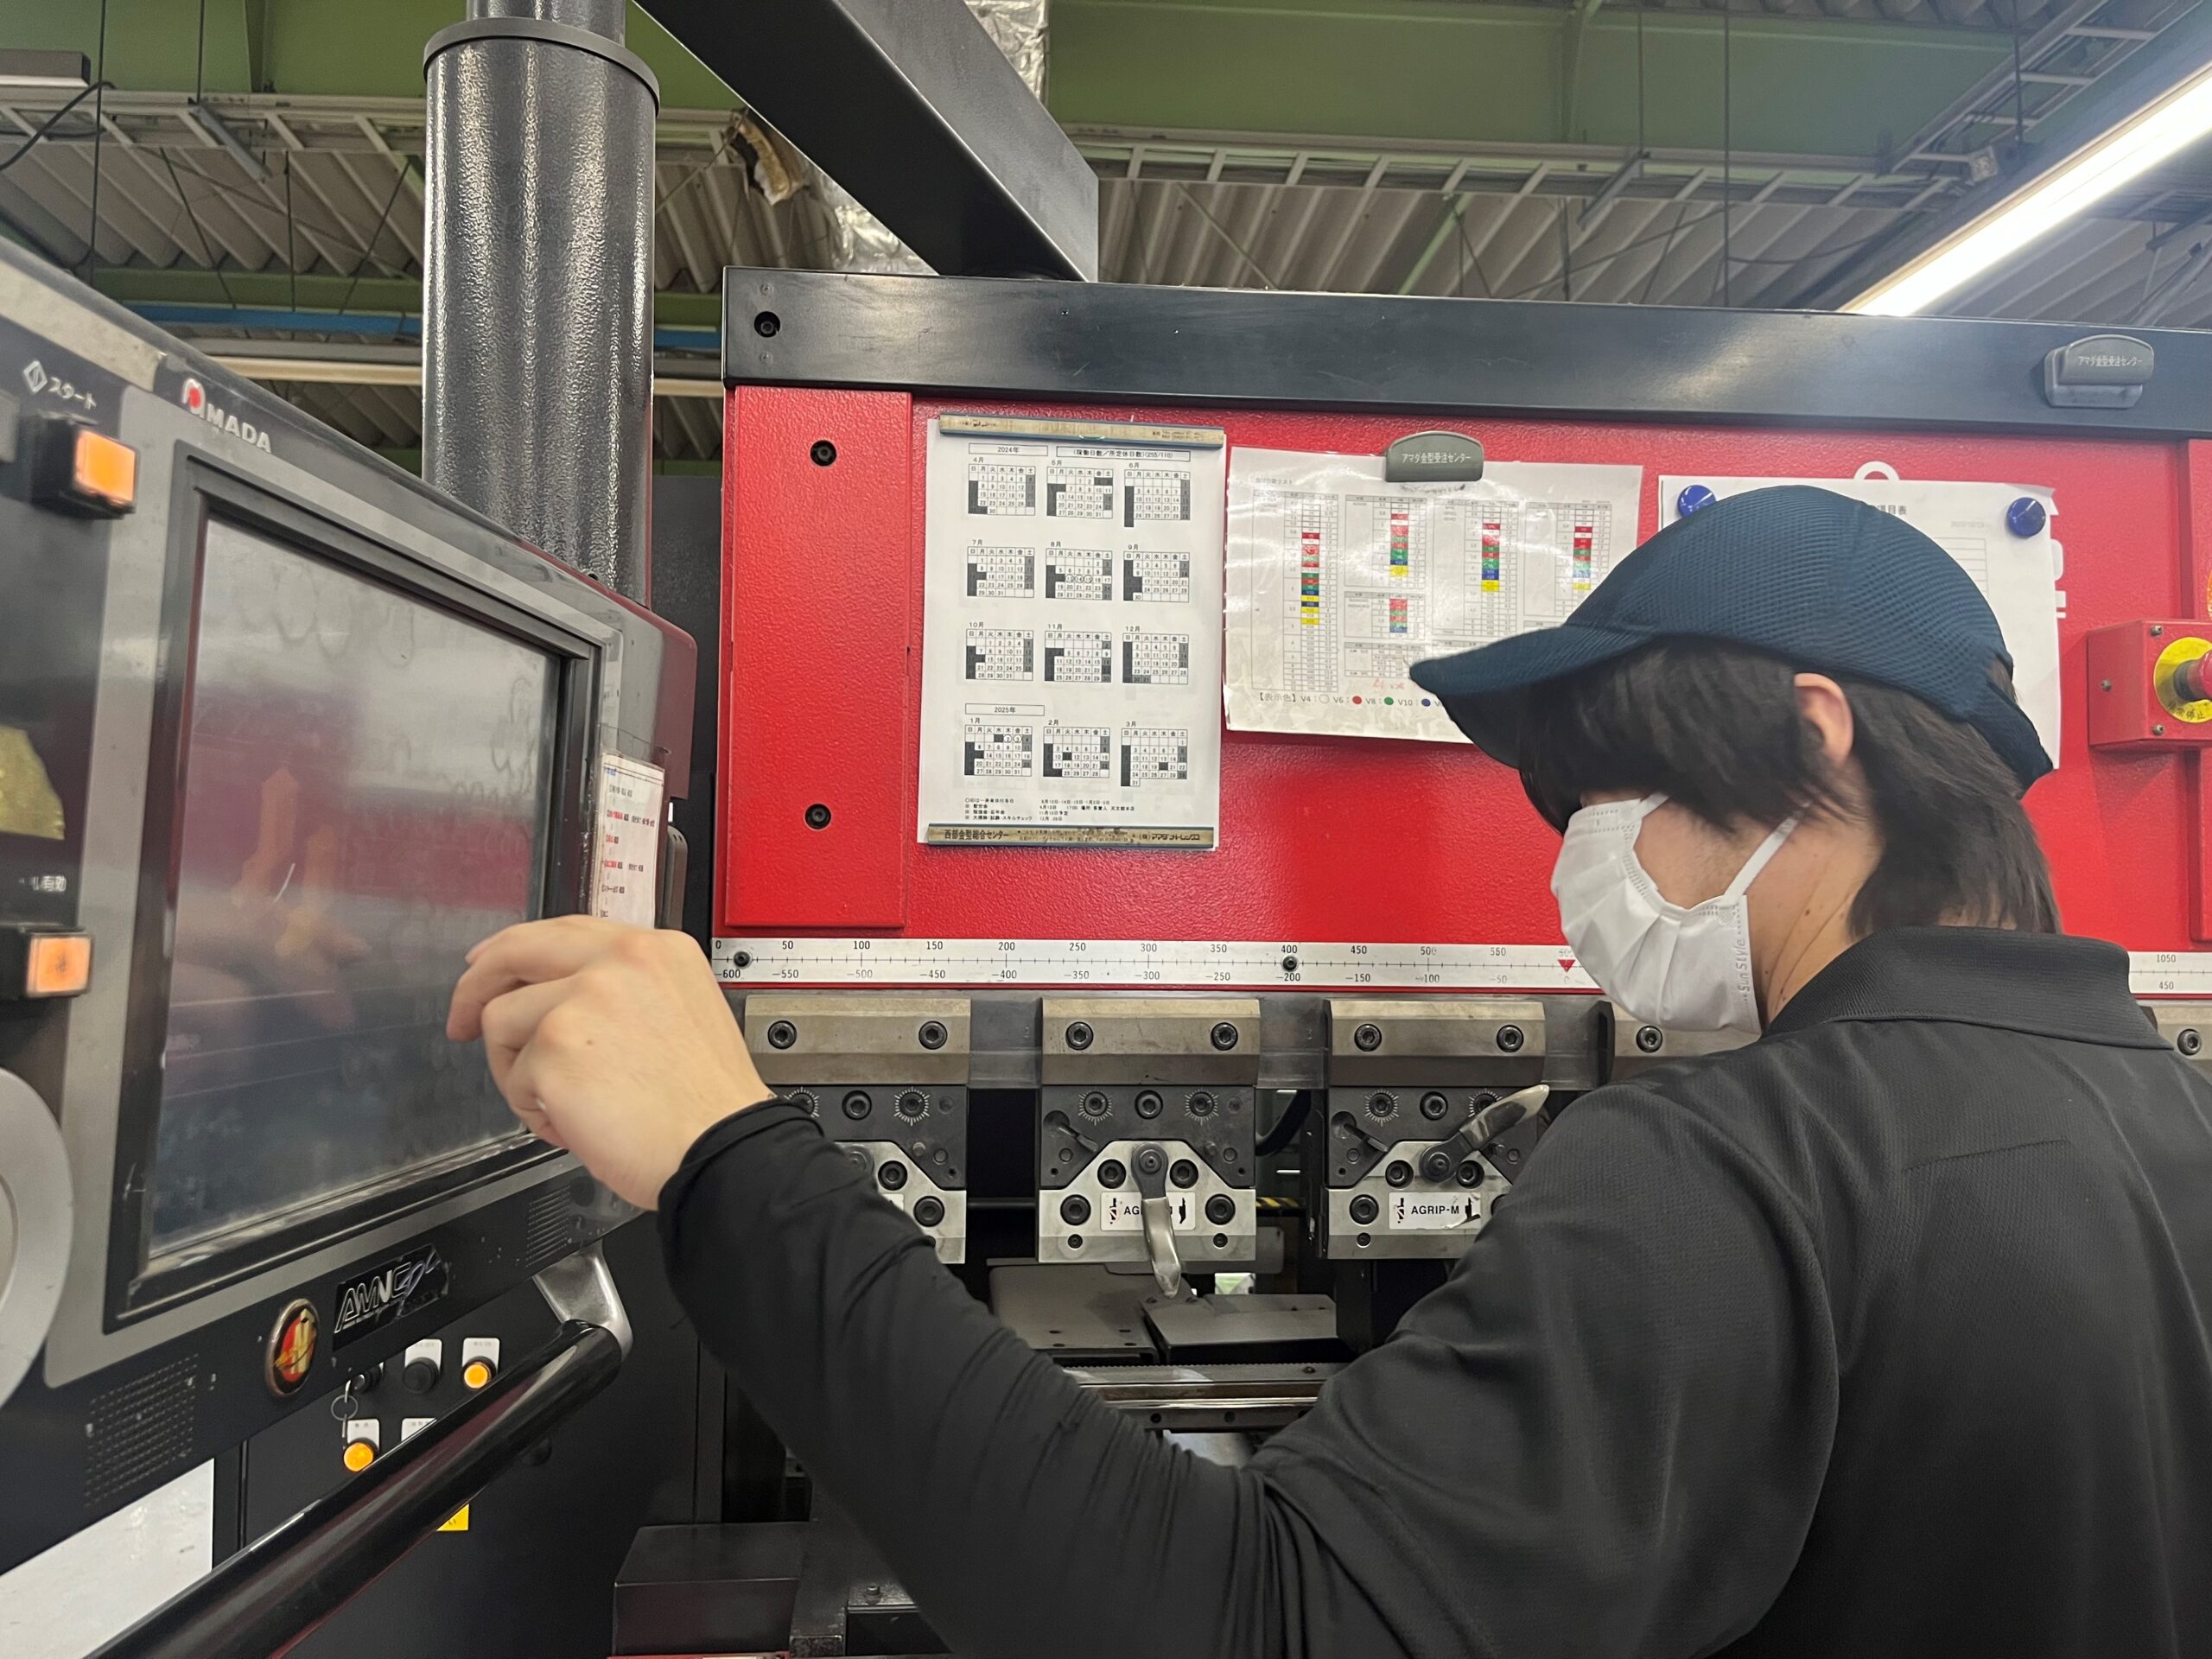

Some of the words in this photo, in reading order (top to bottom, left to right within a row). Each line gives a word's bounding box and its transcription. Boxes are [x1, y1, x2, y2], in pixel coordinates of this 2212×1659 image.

[181, 378, 271, 453] AMADA
[1402, 452, 1471, 464] アマダ金型受注センター
[715, 941, 721, 949] 0
[782, 941, 794, 950] 50
[854, 941, 870, 950] 100
[926, 941, 943, 950] 150
[998, 941, 1015, 951] 200
[1069, 942, 1086, 951] 250
[1140, 943, 1157, 952] 300
[1210, 944, 1227, 953] 350
[1281, 944, 1298, 954] 400
[1350, 945, 1368, 955] 450
[2157, 954, 2176, 963] 1050
[2159, 981, 2174, 990] 450
[1411, 1205, 1460, 1215] AGRIP-M
